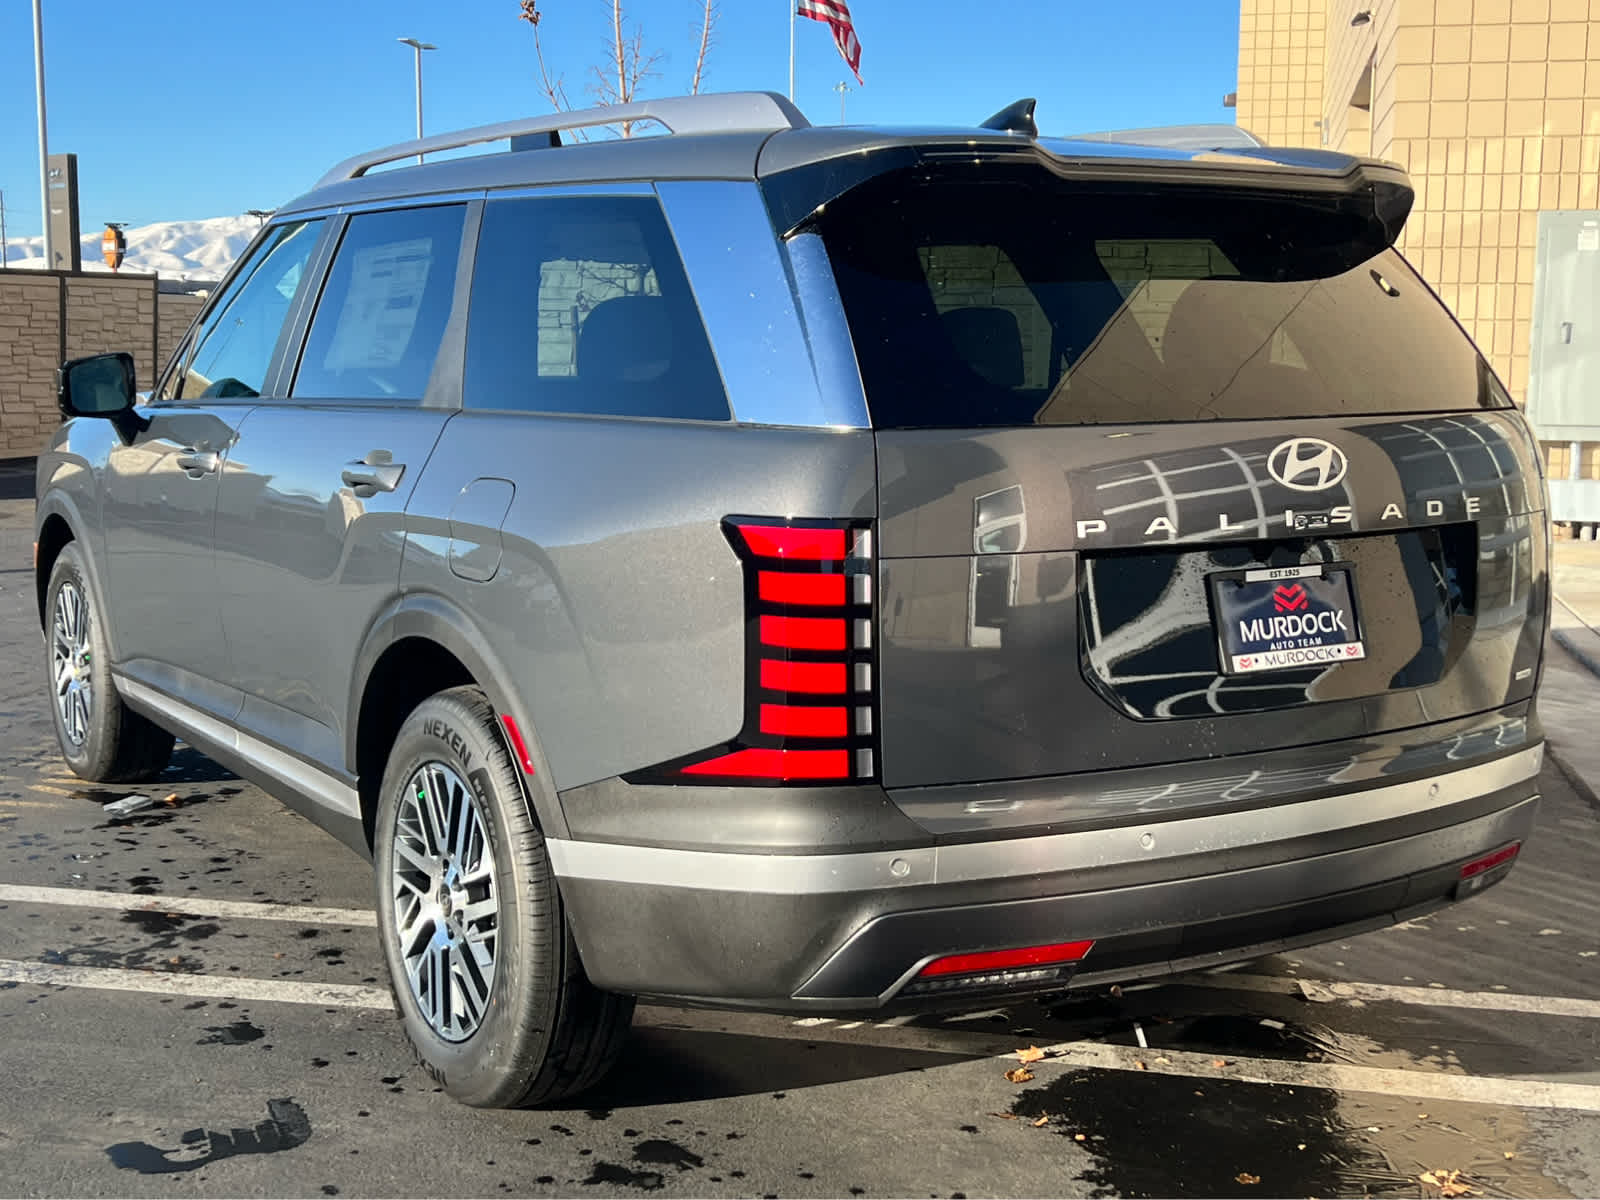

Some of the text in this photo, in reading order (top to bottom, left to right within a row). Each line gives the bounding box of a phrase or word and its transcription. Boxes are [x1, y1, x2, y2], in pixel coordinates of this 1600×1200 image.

[1076, 497, 1481, 539] PALISADE
[1284, 569, 1300, 577] 1925
[1239, 610, 1347, 642] MURDOCK
[1264, 647, 1335, 666] MURDOCK
[1270, 637, 1322, 651] AUTO TEAM
[423, 719, 472, 768] NEXEN
